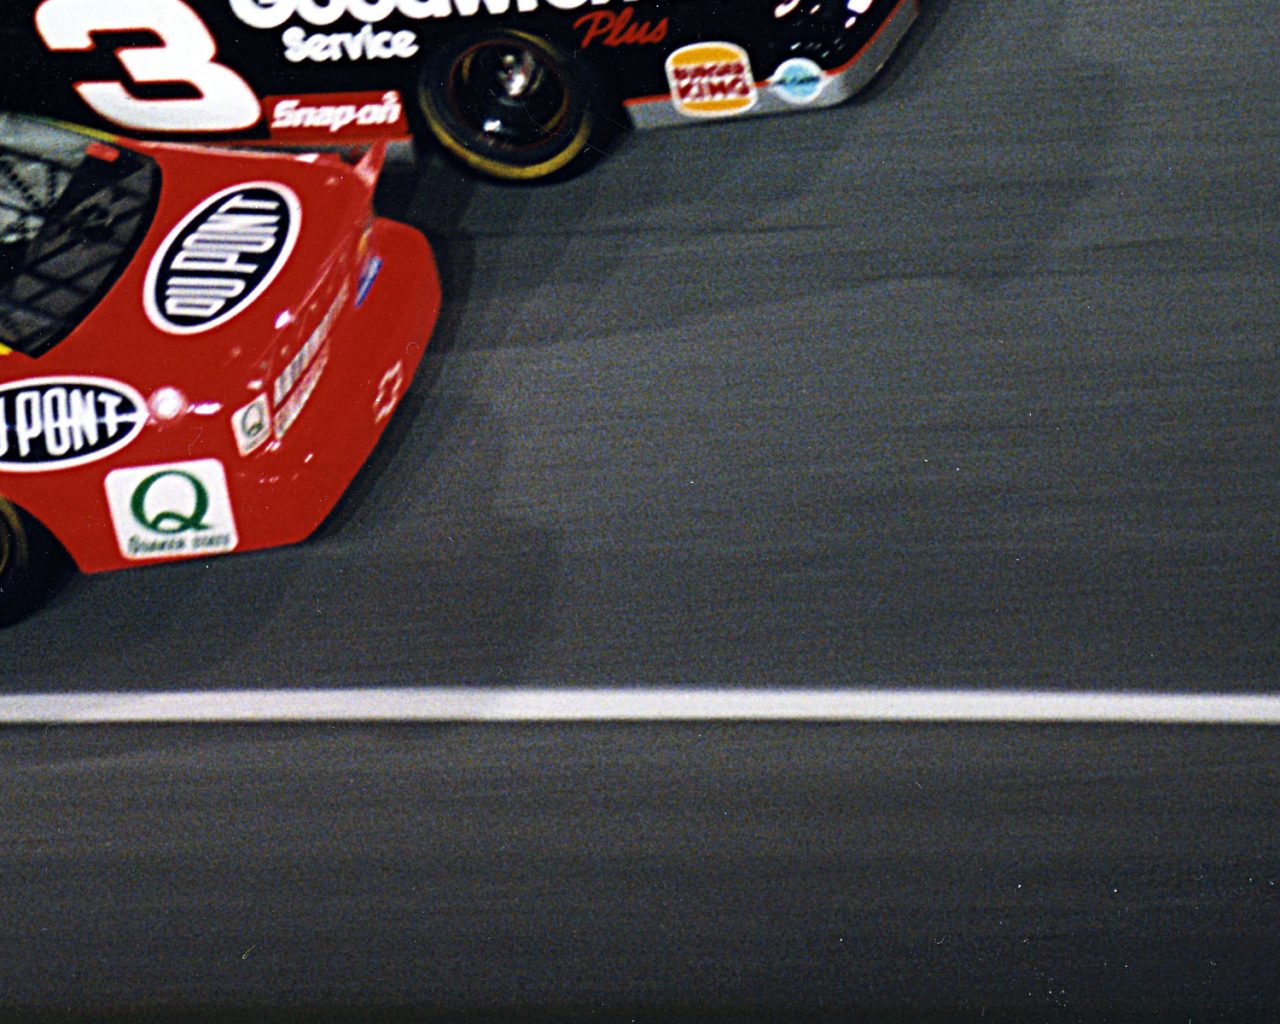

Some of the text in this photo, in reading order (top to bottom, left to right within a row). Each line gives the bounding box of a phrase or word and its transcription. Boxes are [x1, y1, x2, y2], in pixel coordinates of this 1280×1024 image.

[282, 24, 418, 62] Service
[573, 7, 670, 48] Plus
[676, 77, 750, 100] KING
[131, 470, 208, 533] Q
